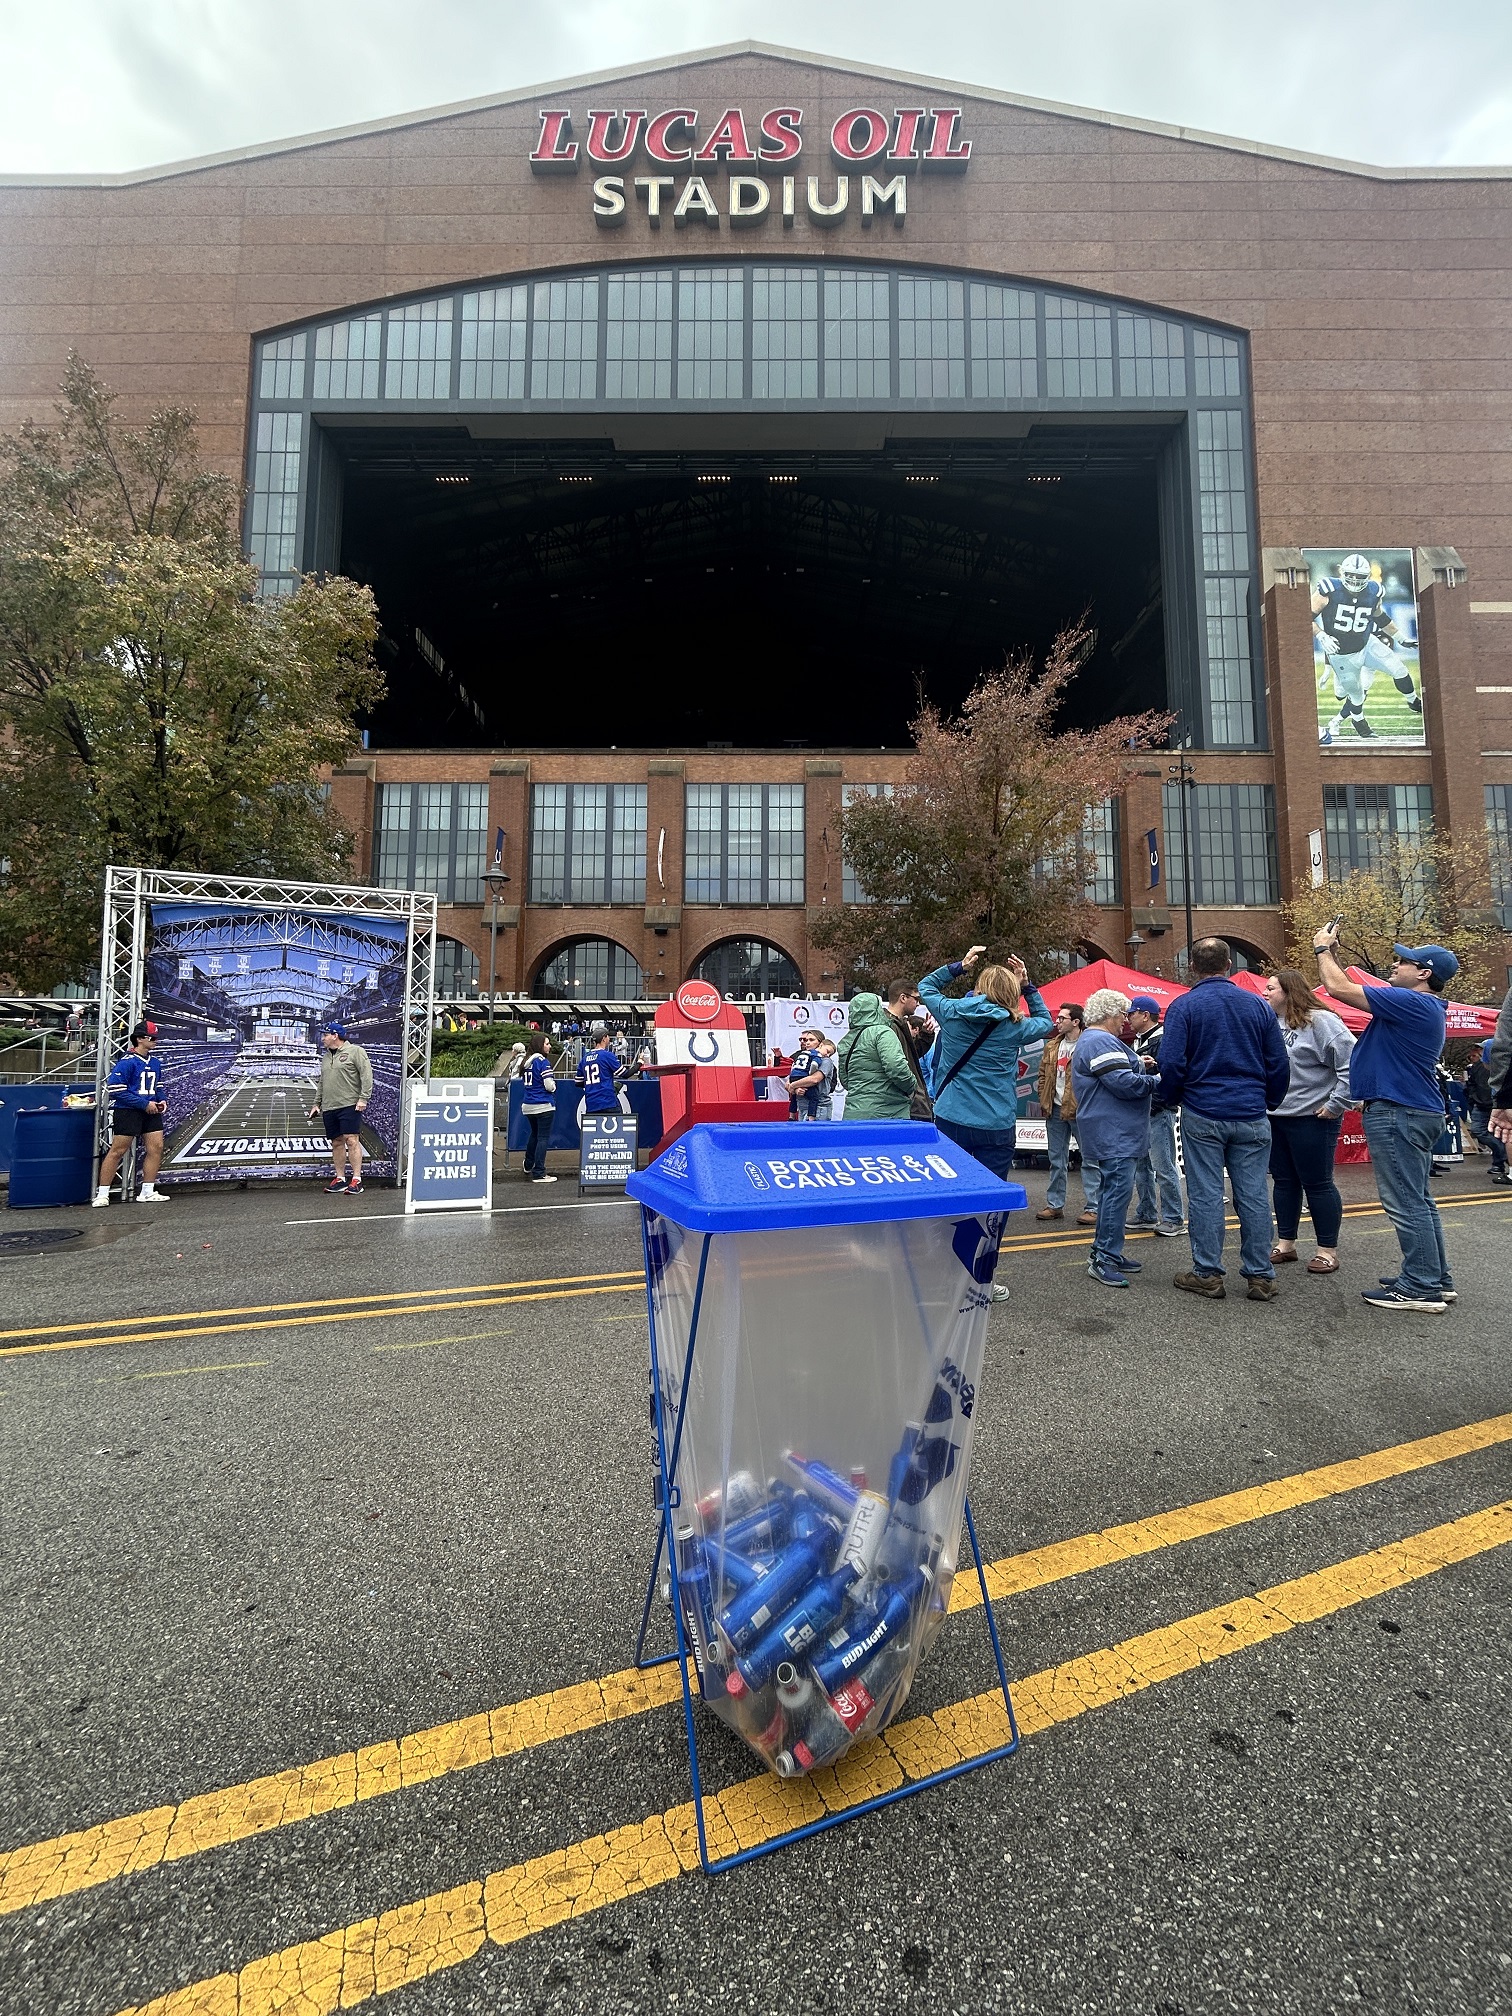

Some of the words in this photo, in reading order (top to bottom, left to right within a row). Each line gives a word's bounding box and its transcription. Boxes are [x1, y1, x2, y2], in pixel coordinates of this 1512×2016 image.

[529, 107, 803, 163] LUCAS
[830, 107, 973, 162] OIL
[592, 175, 907, 218] STADIUM
[1333, 603, 1373, 633] 56
[413, 992, 467, 1001] ORTH
[681, 994, 717, 1007] Coca-Cola
[138, 1071, 156, 1095] 17
[584, 1063, 600, 1085] 12
[421, 1133, 482, 1147] THANK
[1018, 1128, 1046, 1139] Coca-Cola
[433, 1149, 469, 1163] YOU
[588, 1151, 633, 1160] #BUFvsIND
[767, 1156, 897, 1175] BOTTLES
[901, 1154, 924, 1169] &
[423, 1165, 477, 1180] FANS!
[774, 1171, 856, 1189] CANS
[861, 1167, 934, 1185] ONLY
[686, 1610, 700, 1646] LIGHT
[841, 1645, 864, 1669] BUD
[860, 1619, 888, 1651] LIGHT
[694, 1646, 704, 1673] BUD
